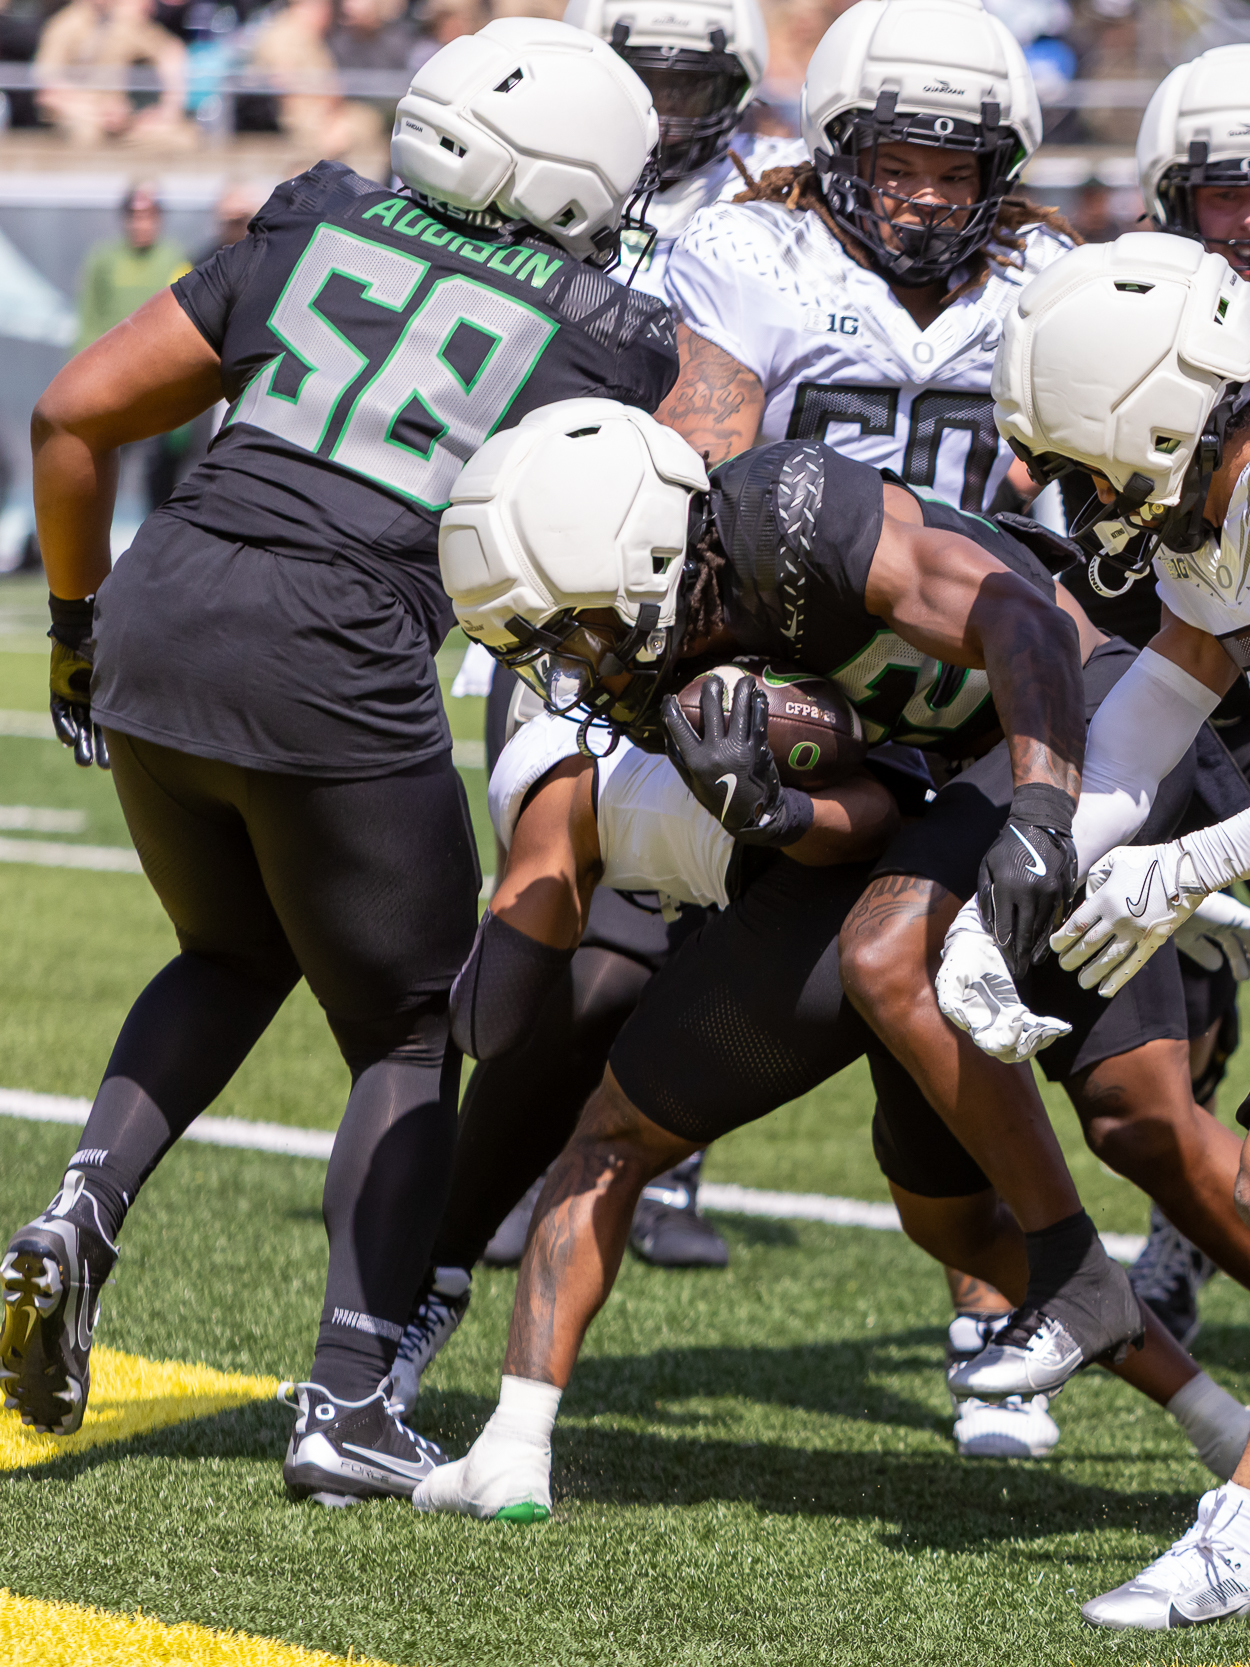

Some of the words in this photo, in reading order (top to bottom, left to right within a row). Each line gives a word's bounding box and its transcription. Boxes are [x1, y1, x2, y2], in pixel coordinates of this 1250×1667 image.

[934, 117, 955, 135] O
[361, 198, 564, 289] ADDISON
[226, 222, 561, 511] 58
[1215, 564, 1233, 590] O
[788, 741, 821, 771] O
[314, 1403, 336, 1421] O
